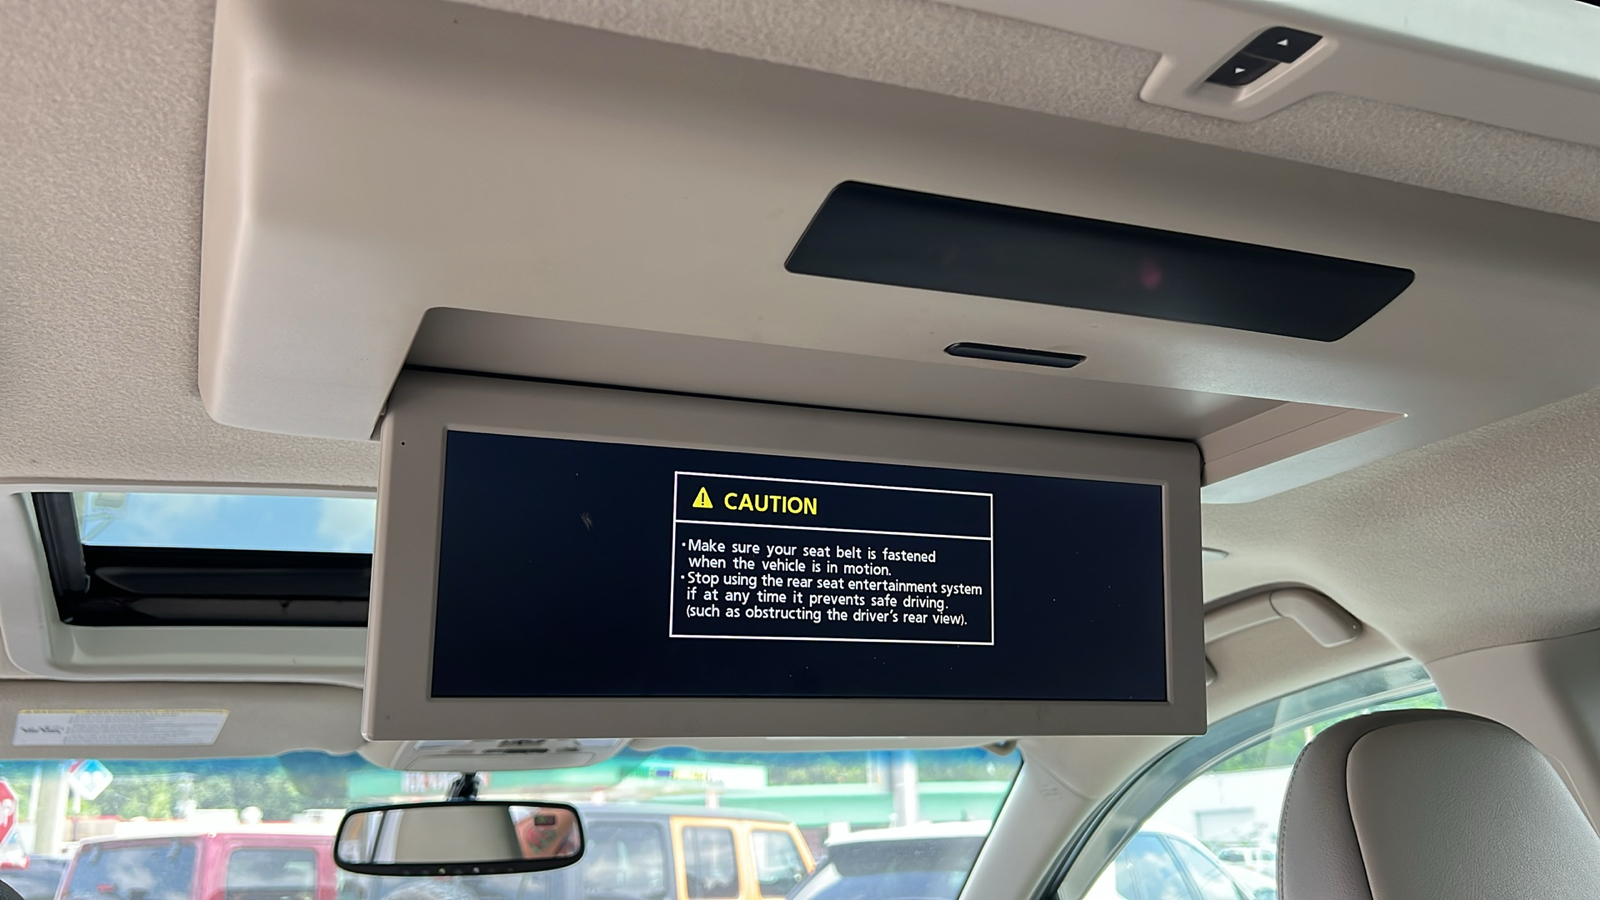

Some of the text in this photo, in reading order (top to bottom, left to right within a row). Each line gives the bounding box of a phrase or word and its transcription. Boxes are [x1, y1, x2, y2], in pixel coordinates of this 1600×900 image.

[724, 493, 817, 515] CAUTION
[689, 539, 936, 562] Make sure your seat belt is fastened
[689, 555, 891, 575] when the vehicle is in motion.
[688, 571, 982, 597] Stop using the rear seat entertainment system
[687, 586, 949, 611] if at any time it prevents safe driving.
[687, 604, 967, 626] (such as obstructing the driver's rear view).
